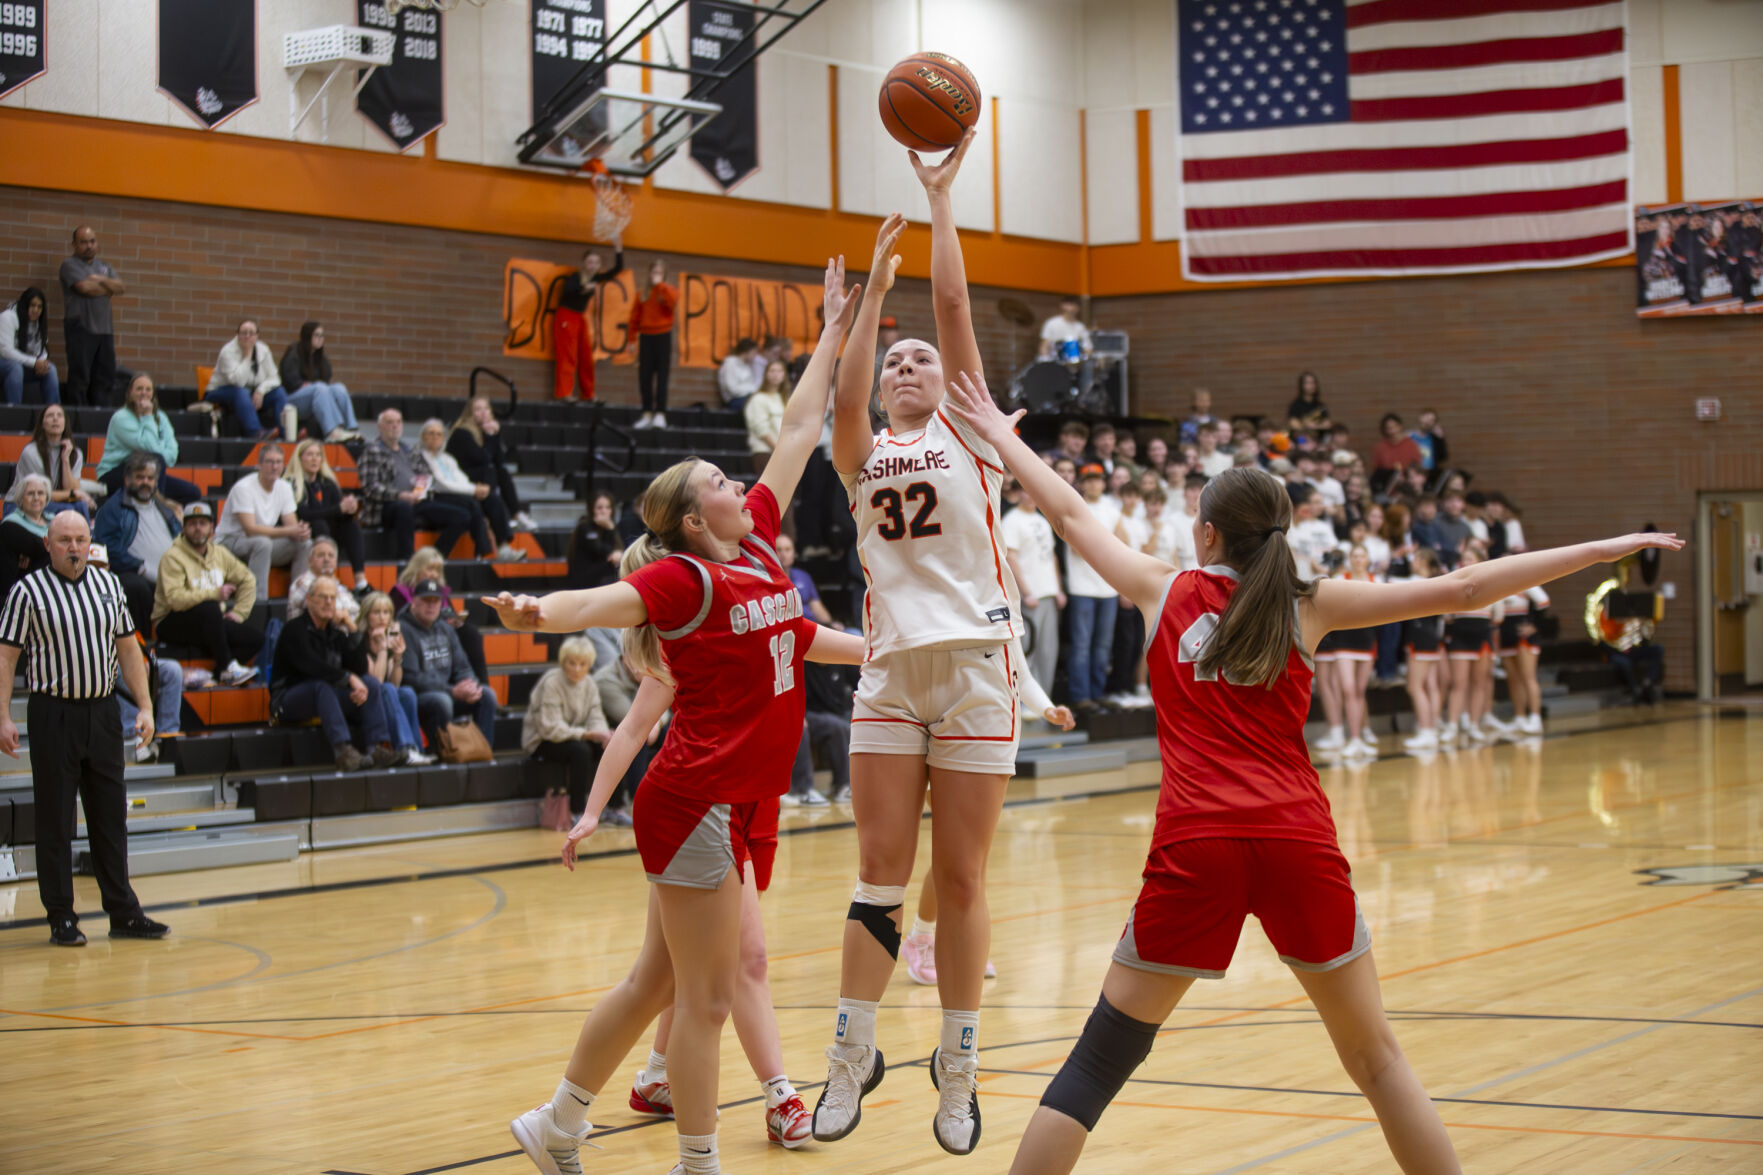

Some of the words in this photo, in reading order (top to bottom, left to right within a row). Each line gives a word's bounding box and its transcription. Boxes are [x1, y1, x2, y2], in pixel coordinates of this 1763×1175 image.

[404, 11, 436, 35] 2013
[536, 8, 566, 33] 1971
[572, 15, 604, 39] 1977
[404, 37, 437, 60] 2018
[535, 33, 568, 58] 1994
[507, 267, 629, 354] DAG
[856, 450, 950, 486] ASHMERE
[870, 481, 943, 542] 32
[768, 629, 797, 698] 12
[1178, 612, 1266, 687] 4
